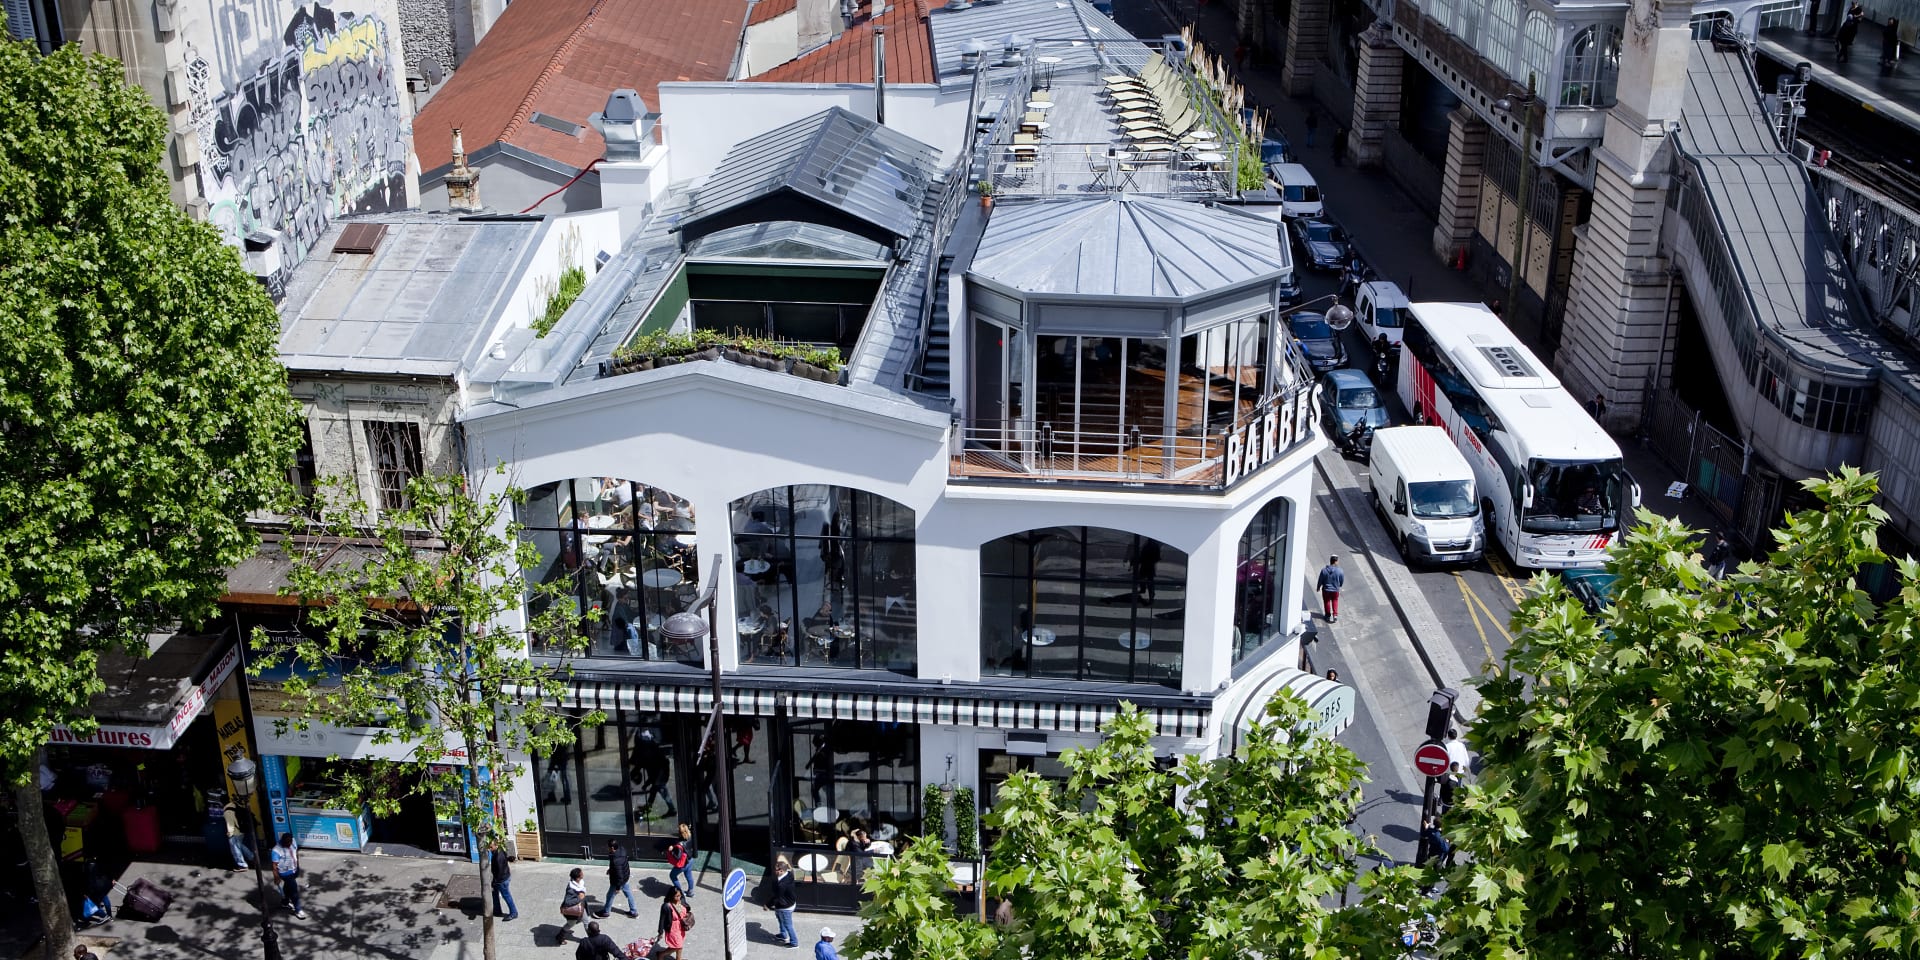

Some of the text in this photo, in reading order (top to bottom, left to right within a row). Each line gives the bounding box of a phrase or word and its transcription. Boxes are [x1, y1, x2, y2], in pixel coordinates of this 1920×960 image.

[171, 698, 194, 731] LINGE
[196, 683, 207, 700] DE
[209, 647, 236, 684] MAISON
